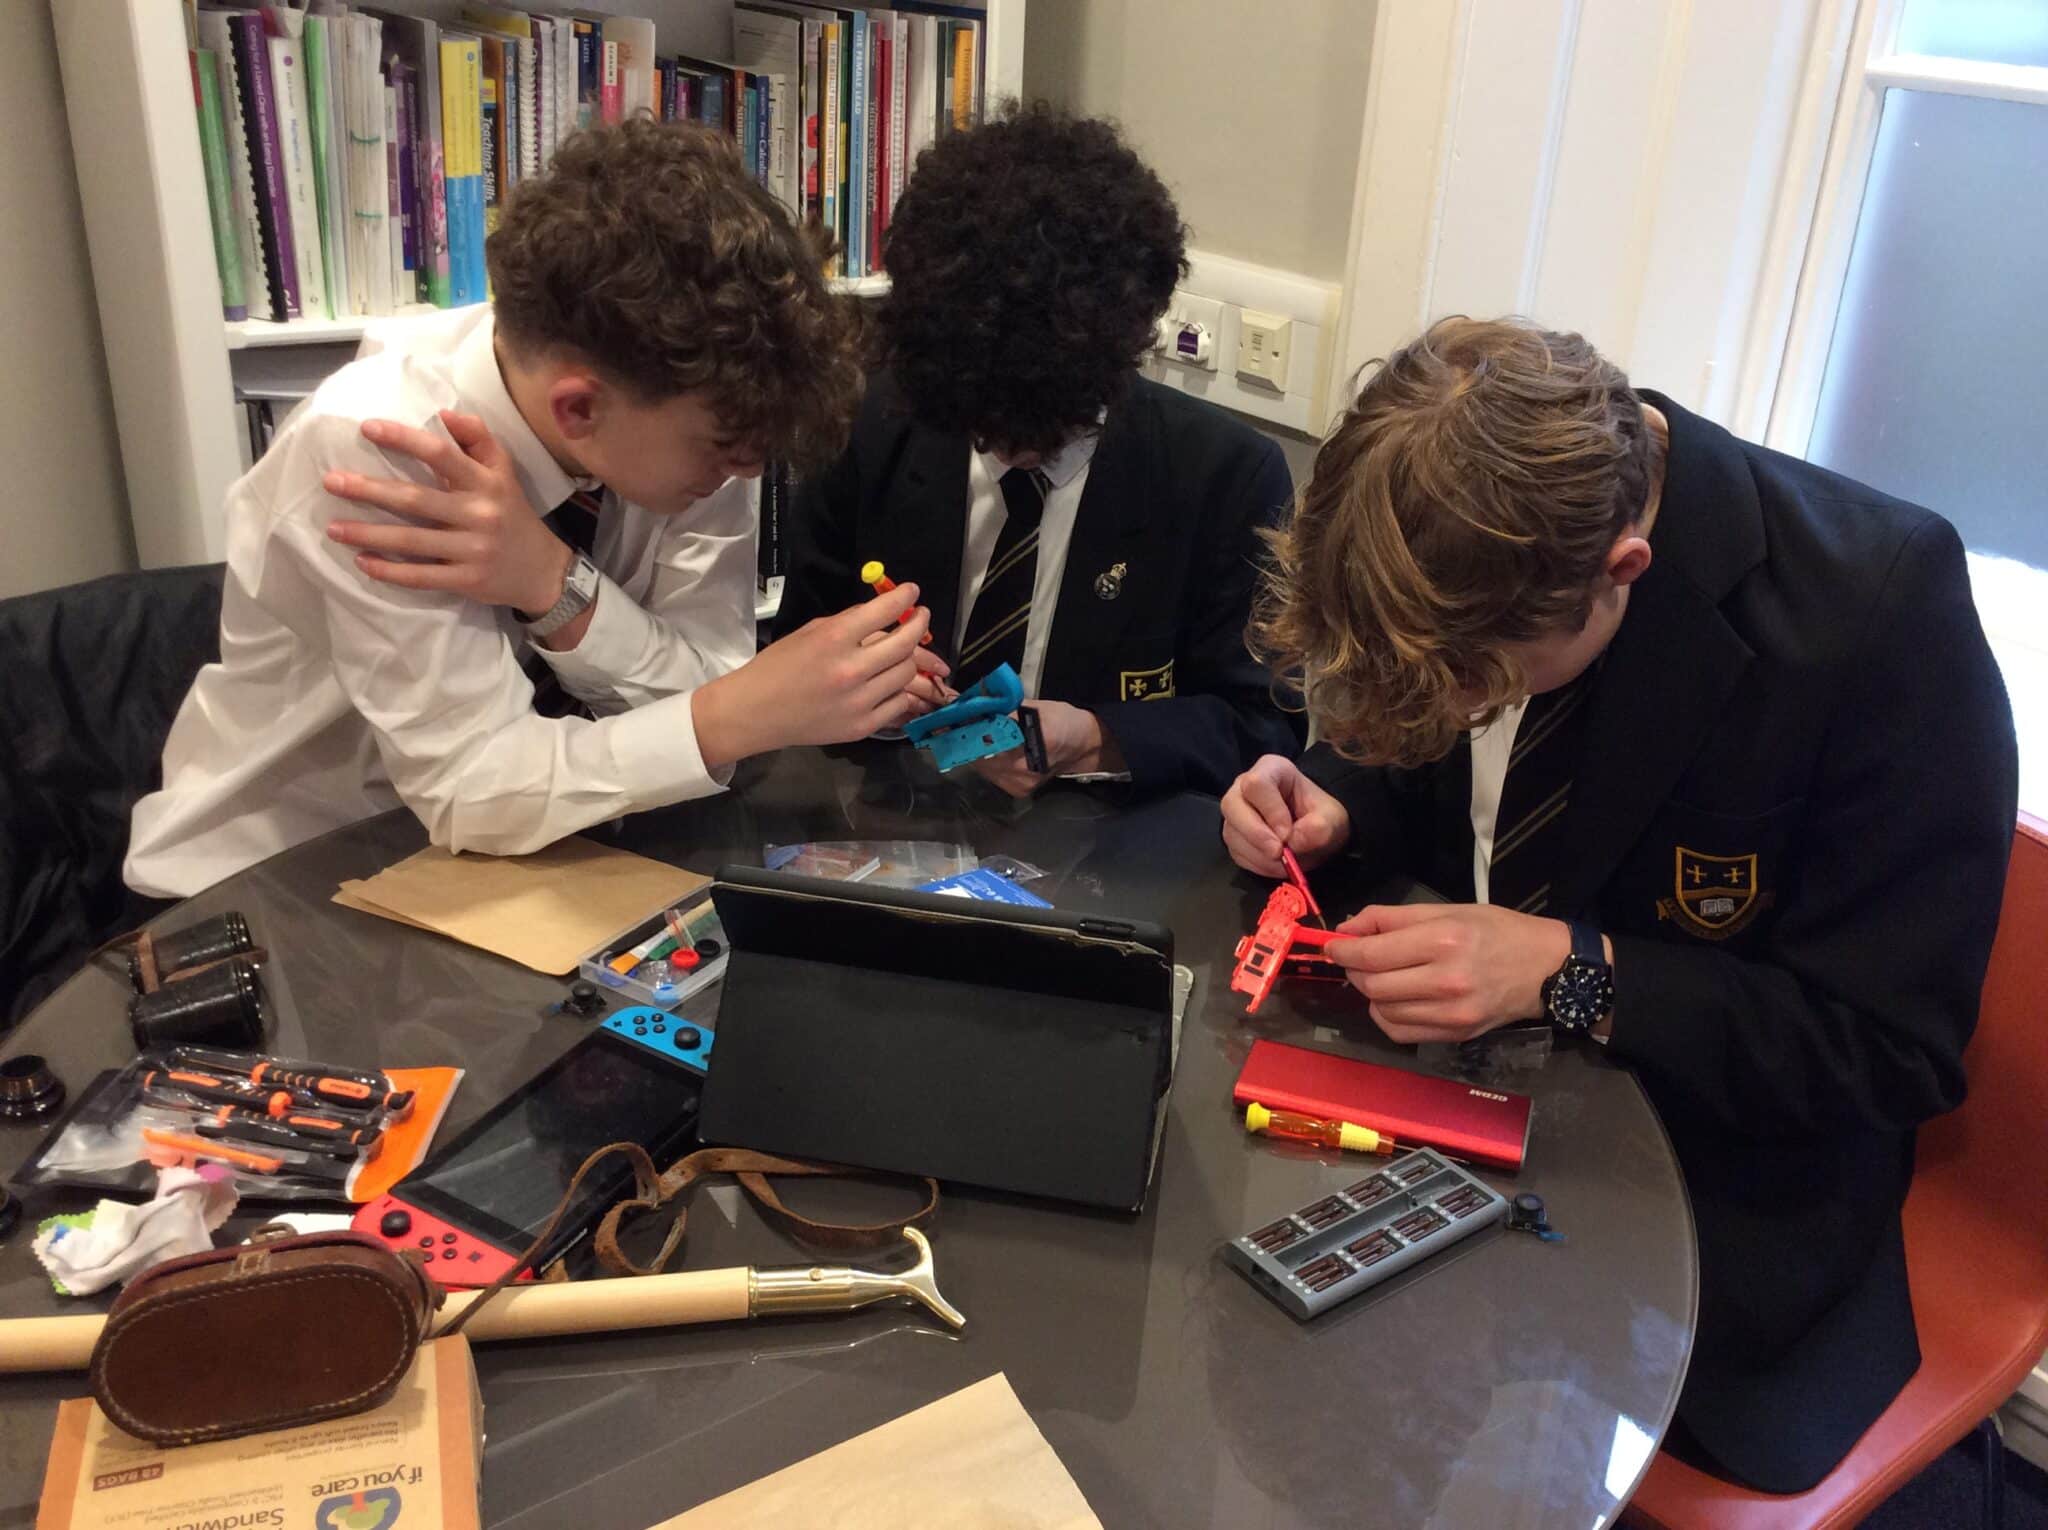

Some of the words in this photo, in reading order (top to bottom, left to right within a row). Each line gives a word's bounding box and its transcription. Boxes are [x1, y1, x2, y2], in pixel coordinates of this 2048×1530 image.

[246, 24, 259, 52] Caring
[855, 29, 863, 48] THE
[854, 50, 863, 87] FEMALE
[254, 70, 265, 96] Loved
[257, 94, 267, 114] One
[854, 90, 862, 114] LEAD
[259, 114, 269, 131] with
[868, 101, 876, 139] THINGS
[262, 141, 274, 165] Eating
[481, 117, 495, 169] Teaching
[266, 165, 278, 198] Disorder
[866, 171, 874, 201] APART
[97, 1471, 138, 1488] BAGS
[311, 1477, 359, 1498] care
[364, 1464, 406, 1487] you
[408, 1466, 423, 1485] if
